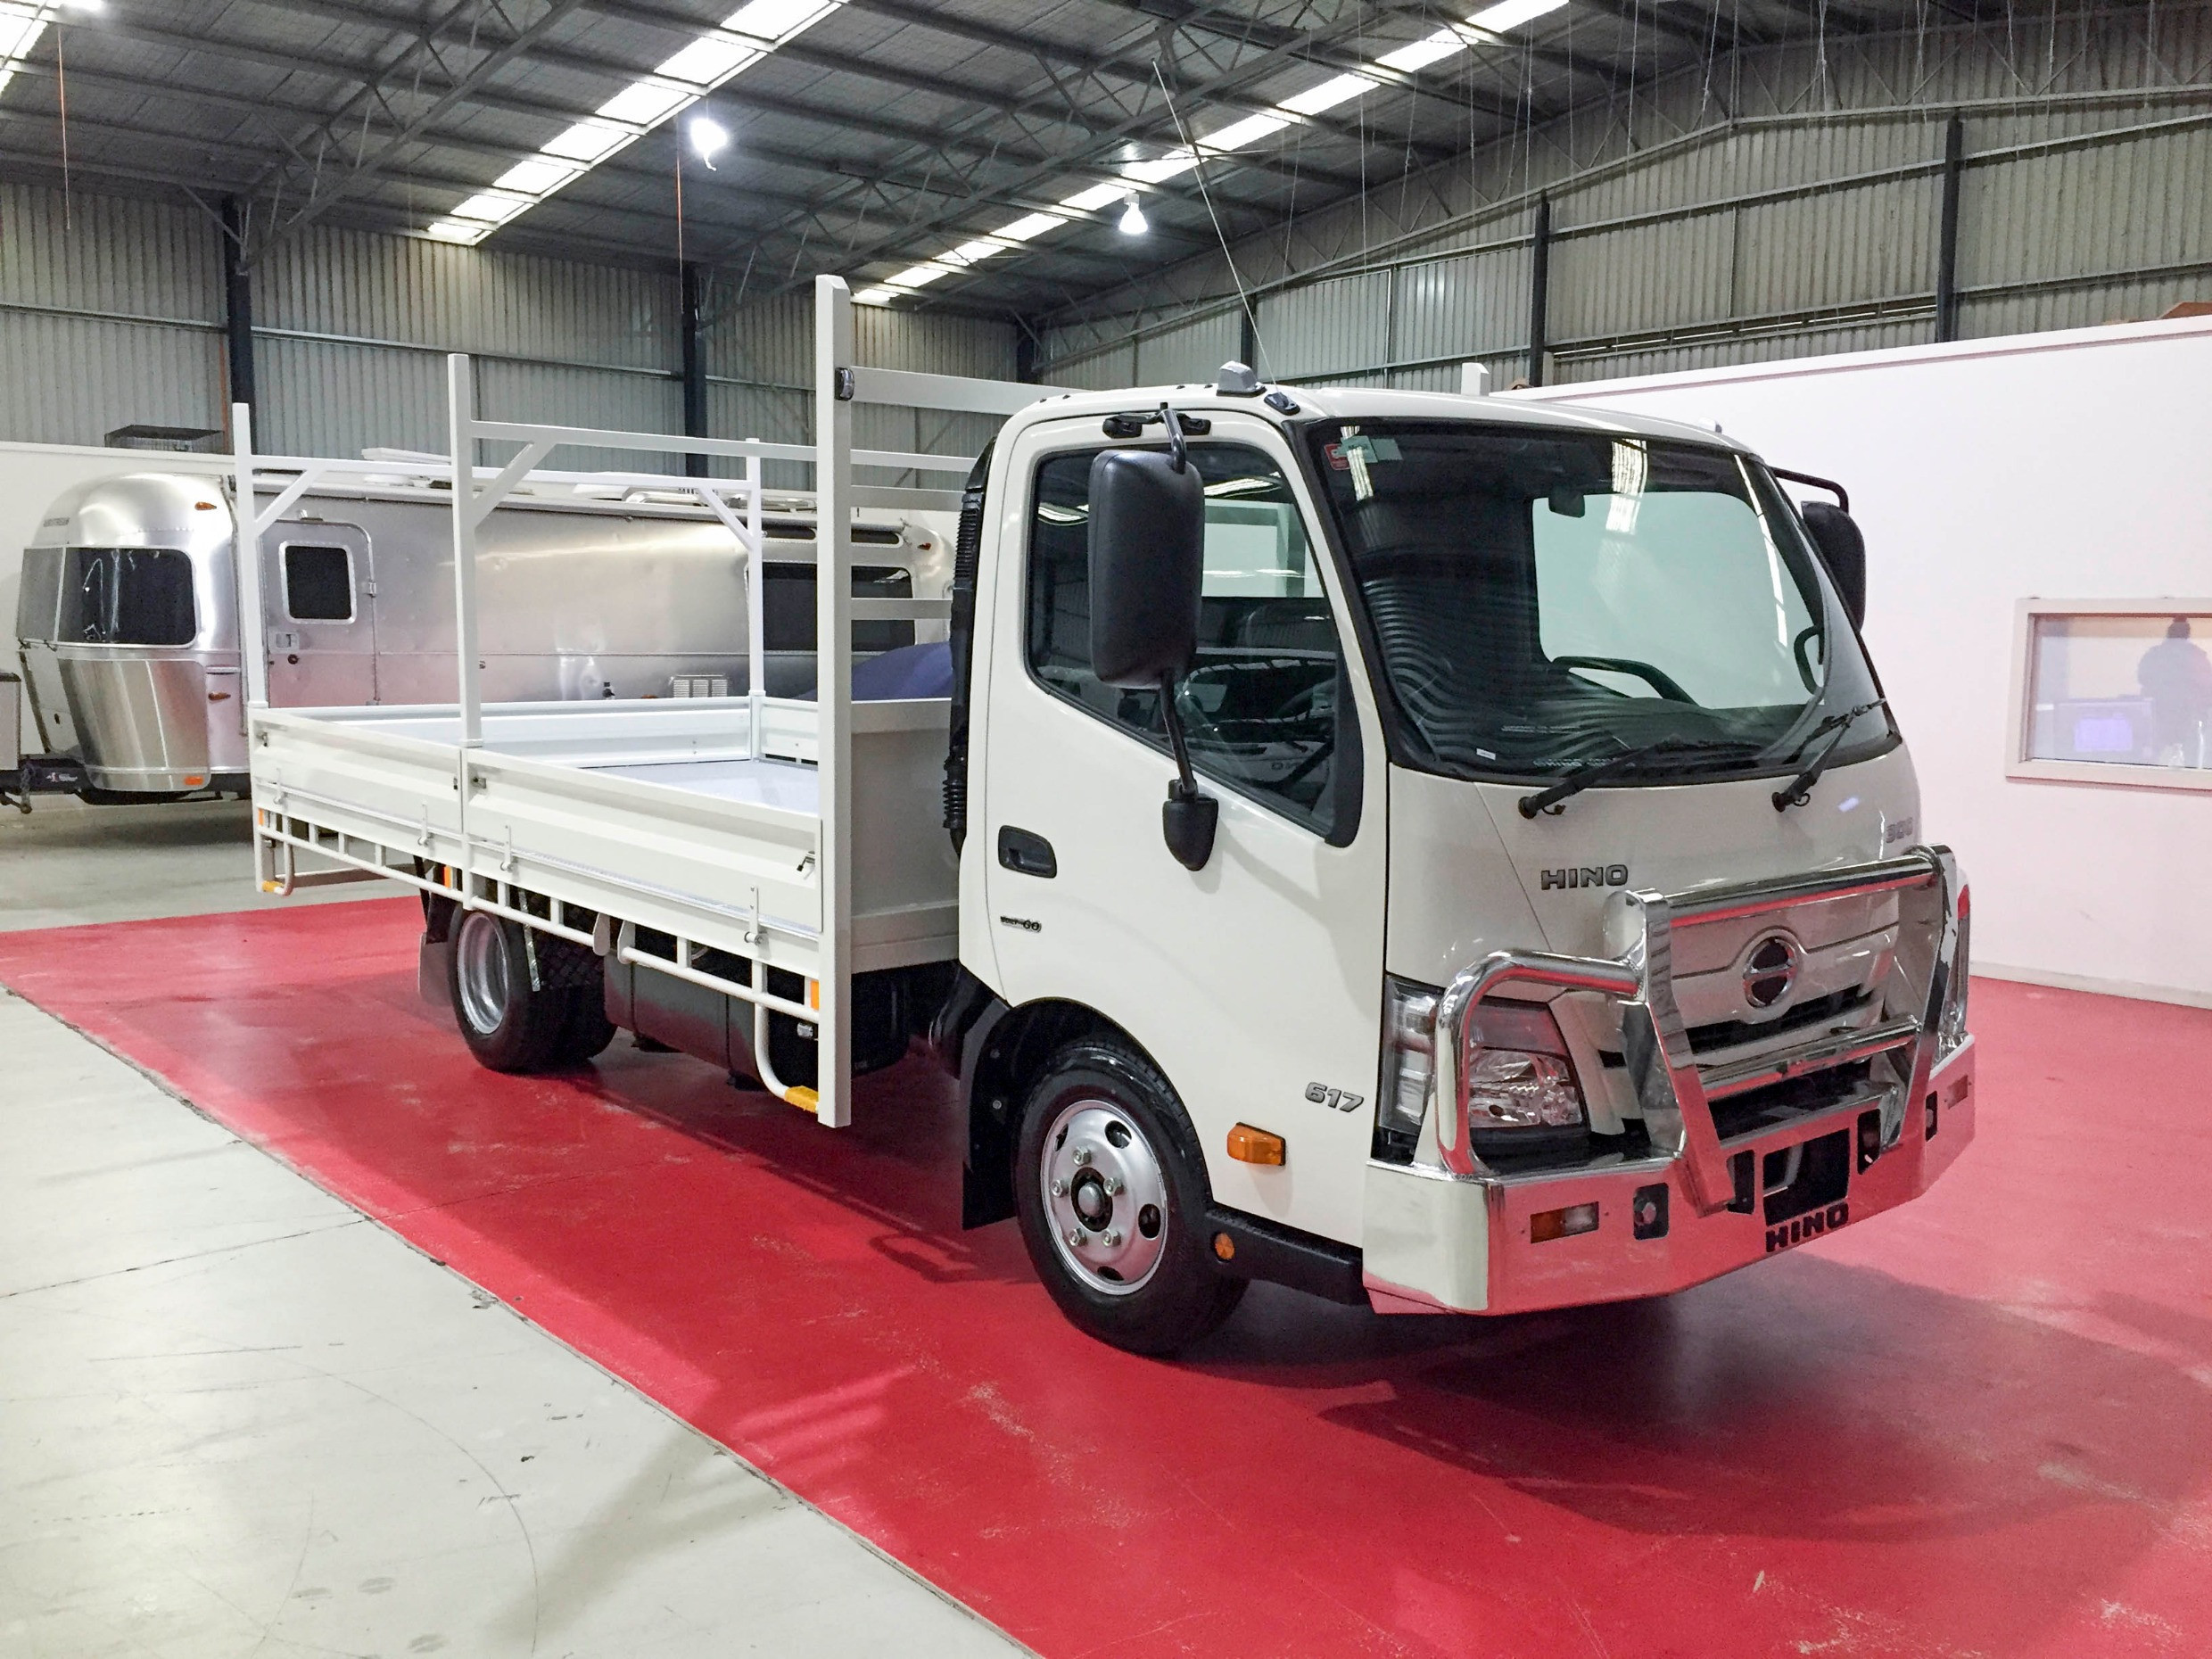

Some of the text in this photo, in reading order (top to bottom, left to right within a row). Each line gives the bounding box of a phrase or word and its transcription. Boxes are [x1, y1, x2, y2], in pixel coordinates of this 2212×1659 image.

[1540, 864, 1628, 890] HINO
[1305, 1082, 1364, 1112] 617
[1766, 1203, 1849, 1252] HINO
